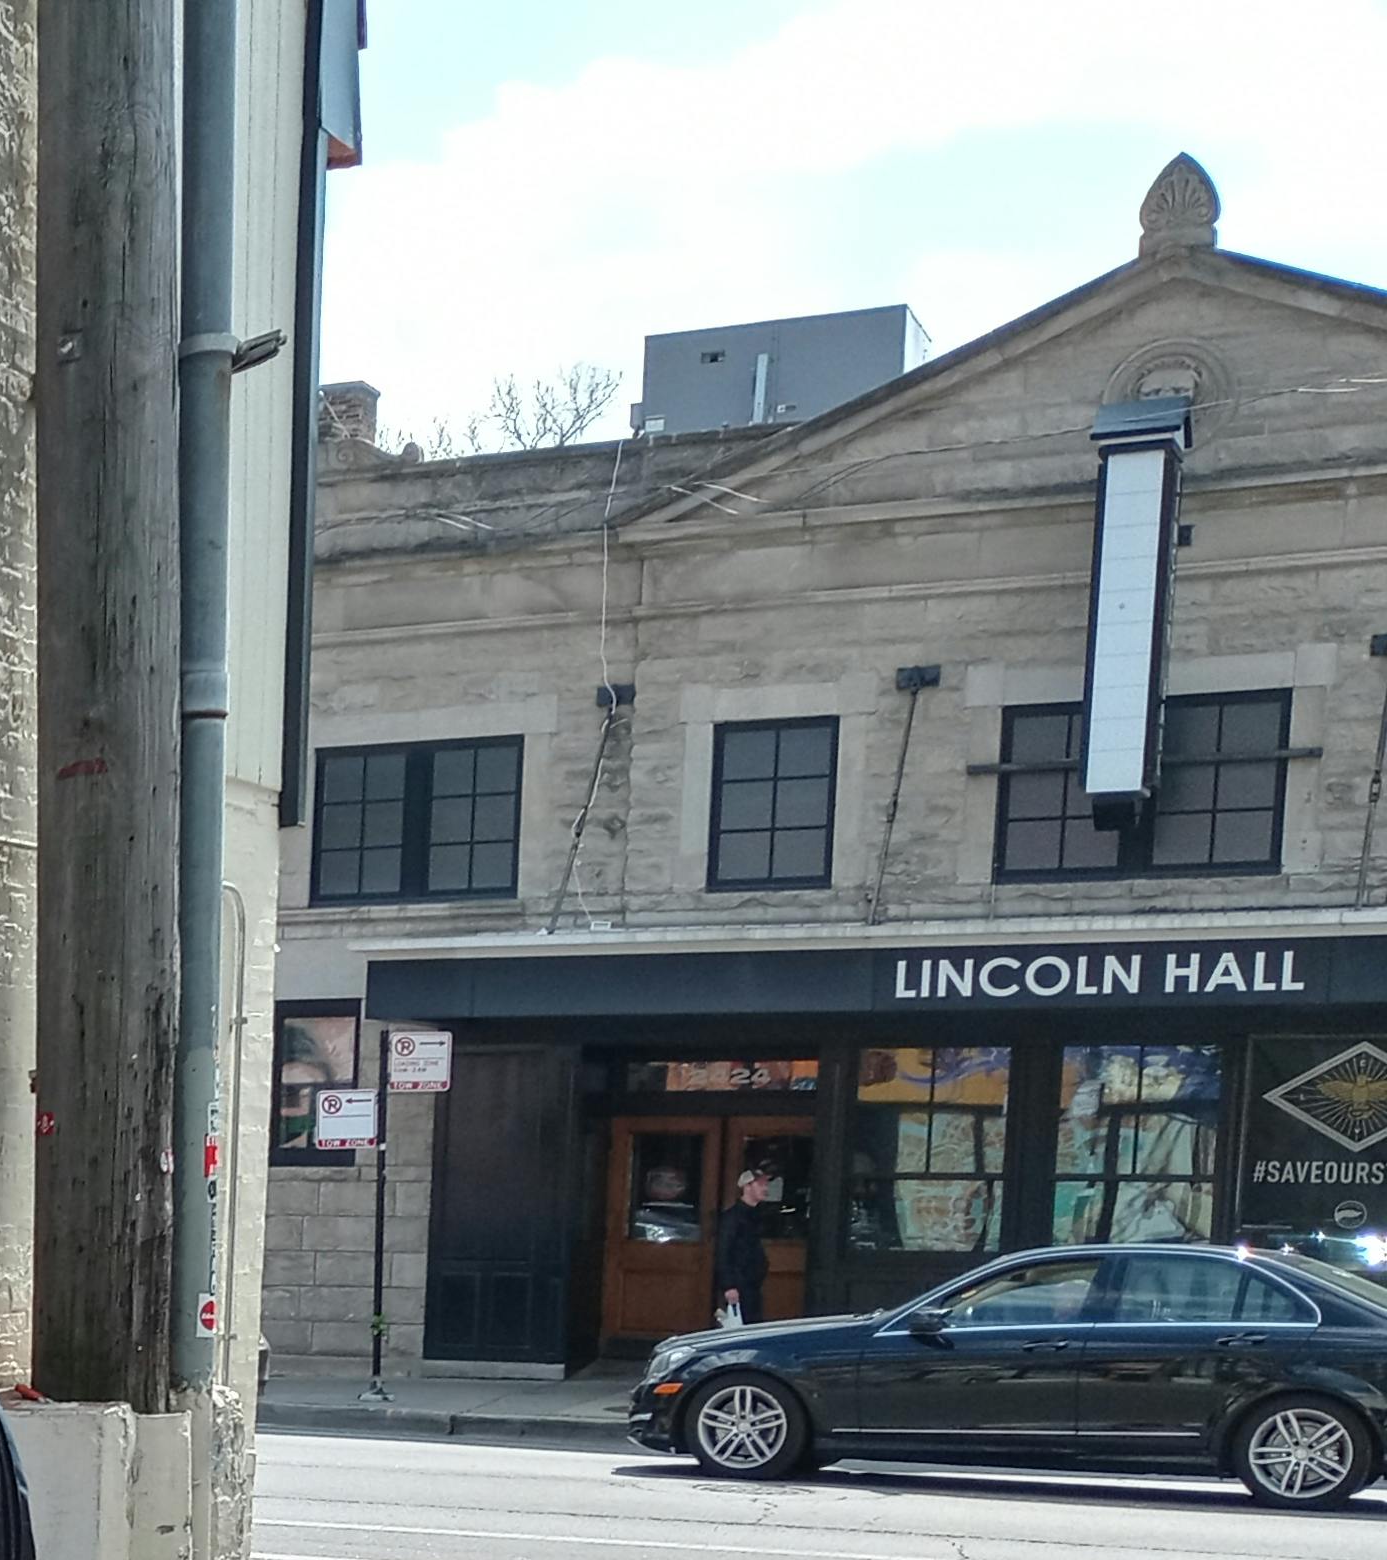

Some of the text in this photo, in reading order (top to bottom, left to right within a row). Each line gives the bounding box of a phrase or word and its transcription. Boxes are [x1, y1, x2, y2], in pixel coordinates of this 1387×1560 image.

[895, 950, 1305, 999] LINCOLN HALL
[1253, 1160, 1387, 1184] #SAVEOURS
